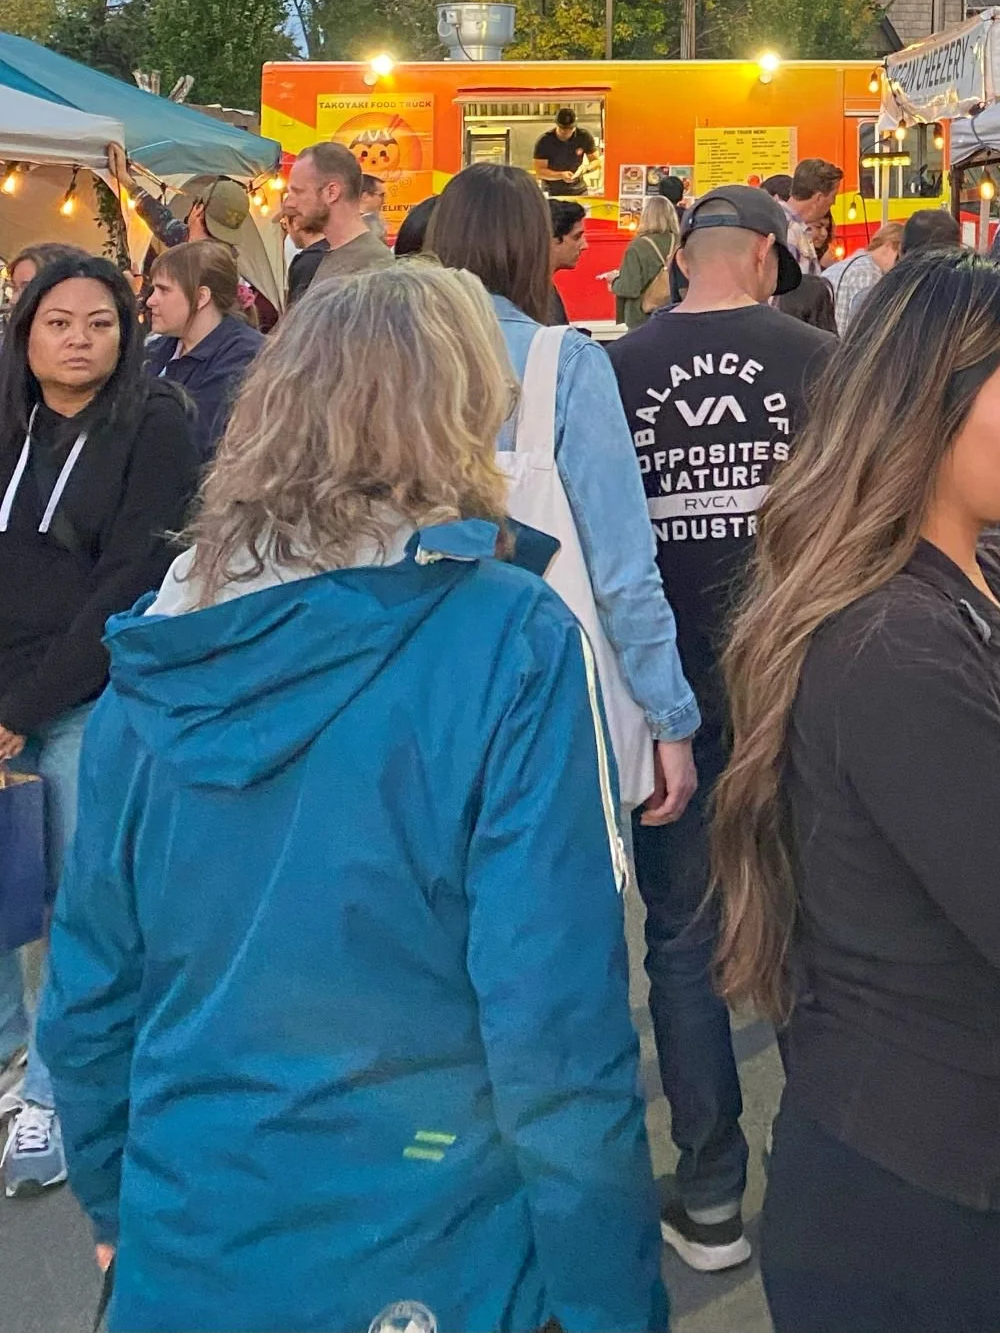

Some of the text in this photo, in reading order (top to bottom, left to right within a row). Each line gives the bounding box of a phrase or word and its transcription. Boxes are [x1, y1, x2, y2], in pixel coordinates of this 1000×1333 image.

[916, 35, 970, 91] CHEEZERY
[634, 352, 789, 447] BALANCE OF
[638, 441, 790, 473] OPPOSITES
[659, 464, 762, 493] NATURE
